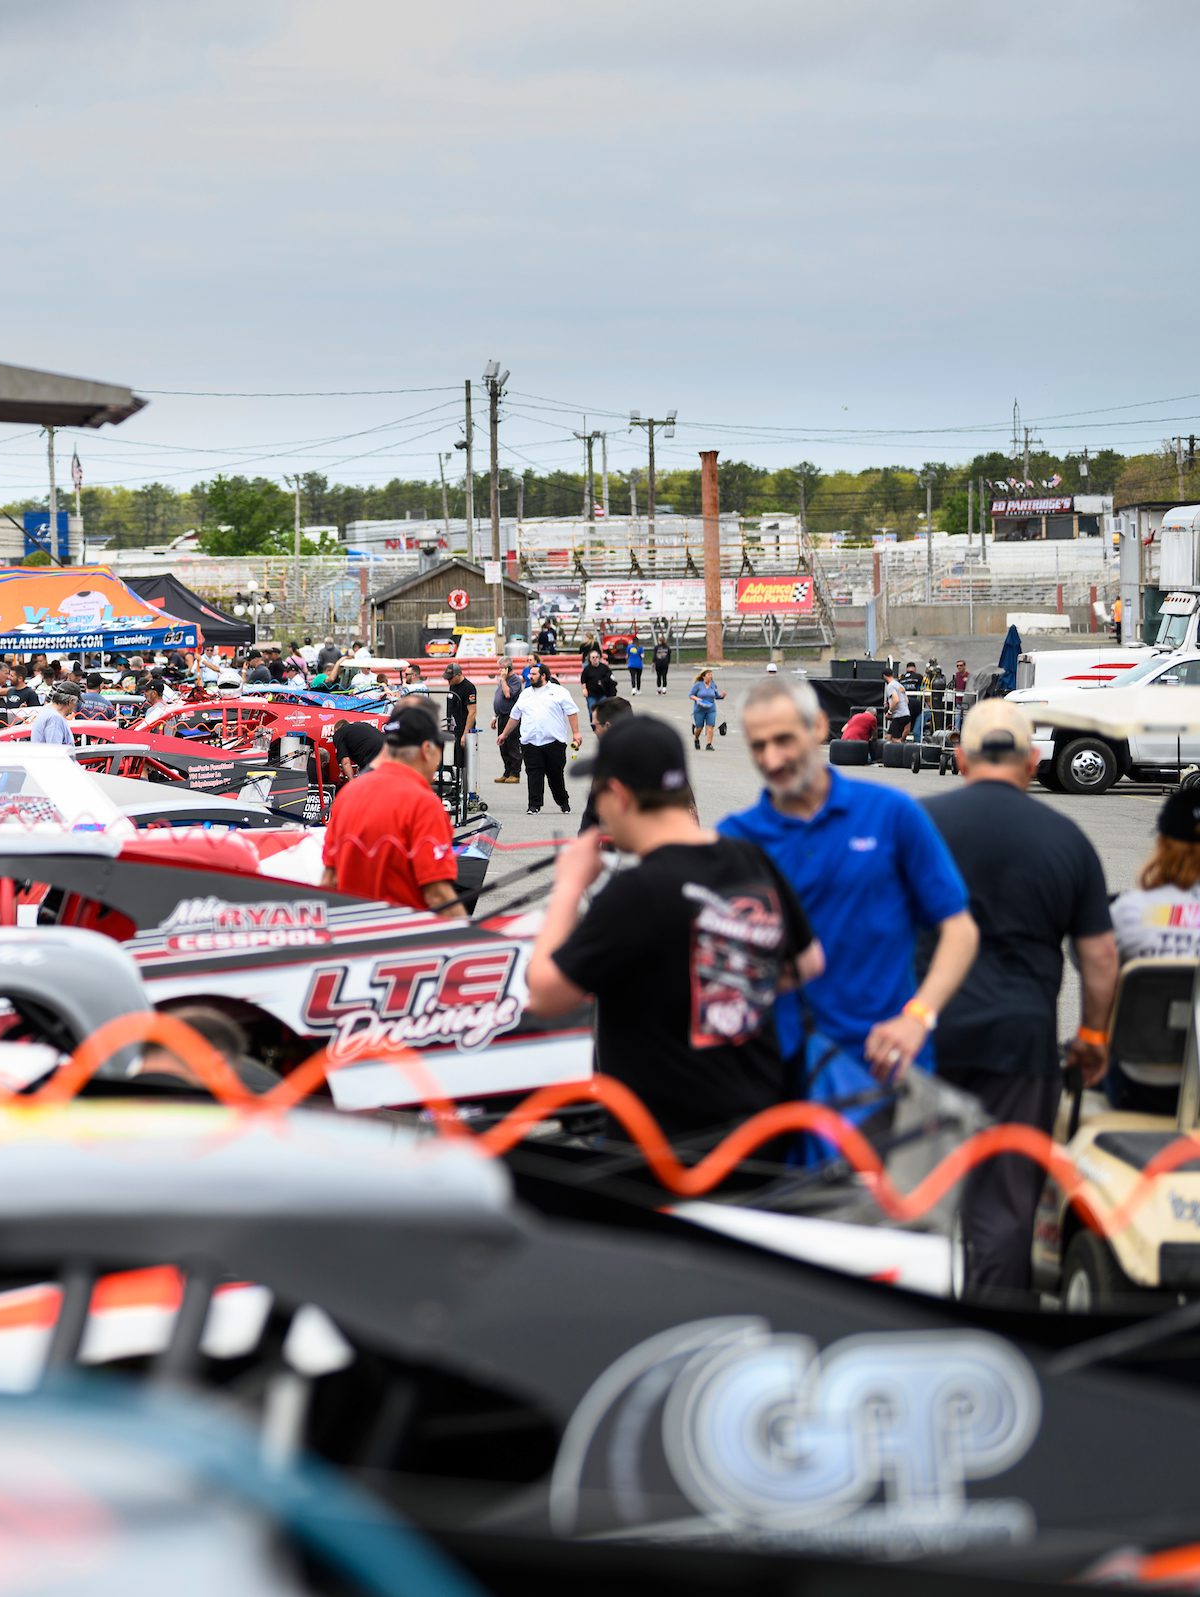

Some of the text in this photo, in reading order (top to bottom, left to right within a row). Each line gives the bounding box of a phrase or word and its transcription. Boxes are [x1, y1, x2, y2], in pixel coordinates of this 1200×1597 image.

[992, 498, 1072, 511] ED PARTRIDGE'S
[745, 583, 792, 594] Advance
[739, 594, 788, 603] Auto Parts
[113, 635, 153, 646] Embroidery
[163, 631, 183, 645] 64
[216, 903, 326, 928] RYAN
[176, 930, 327, 951] CESSPOOL
[302, 944, 520, 1027] LTE
[334, 998, 517, 1057] Drainage
